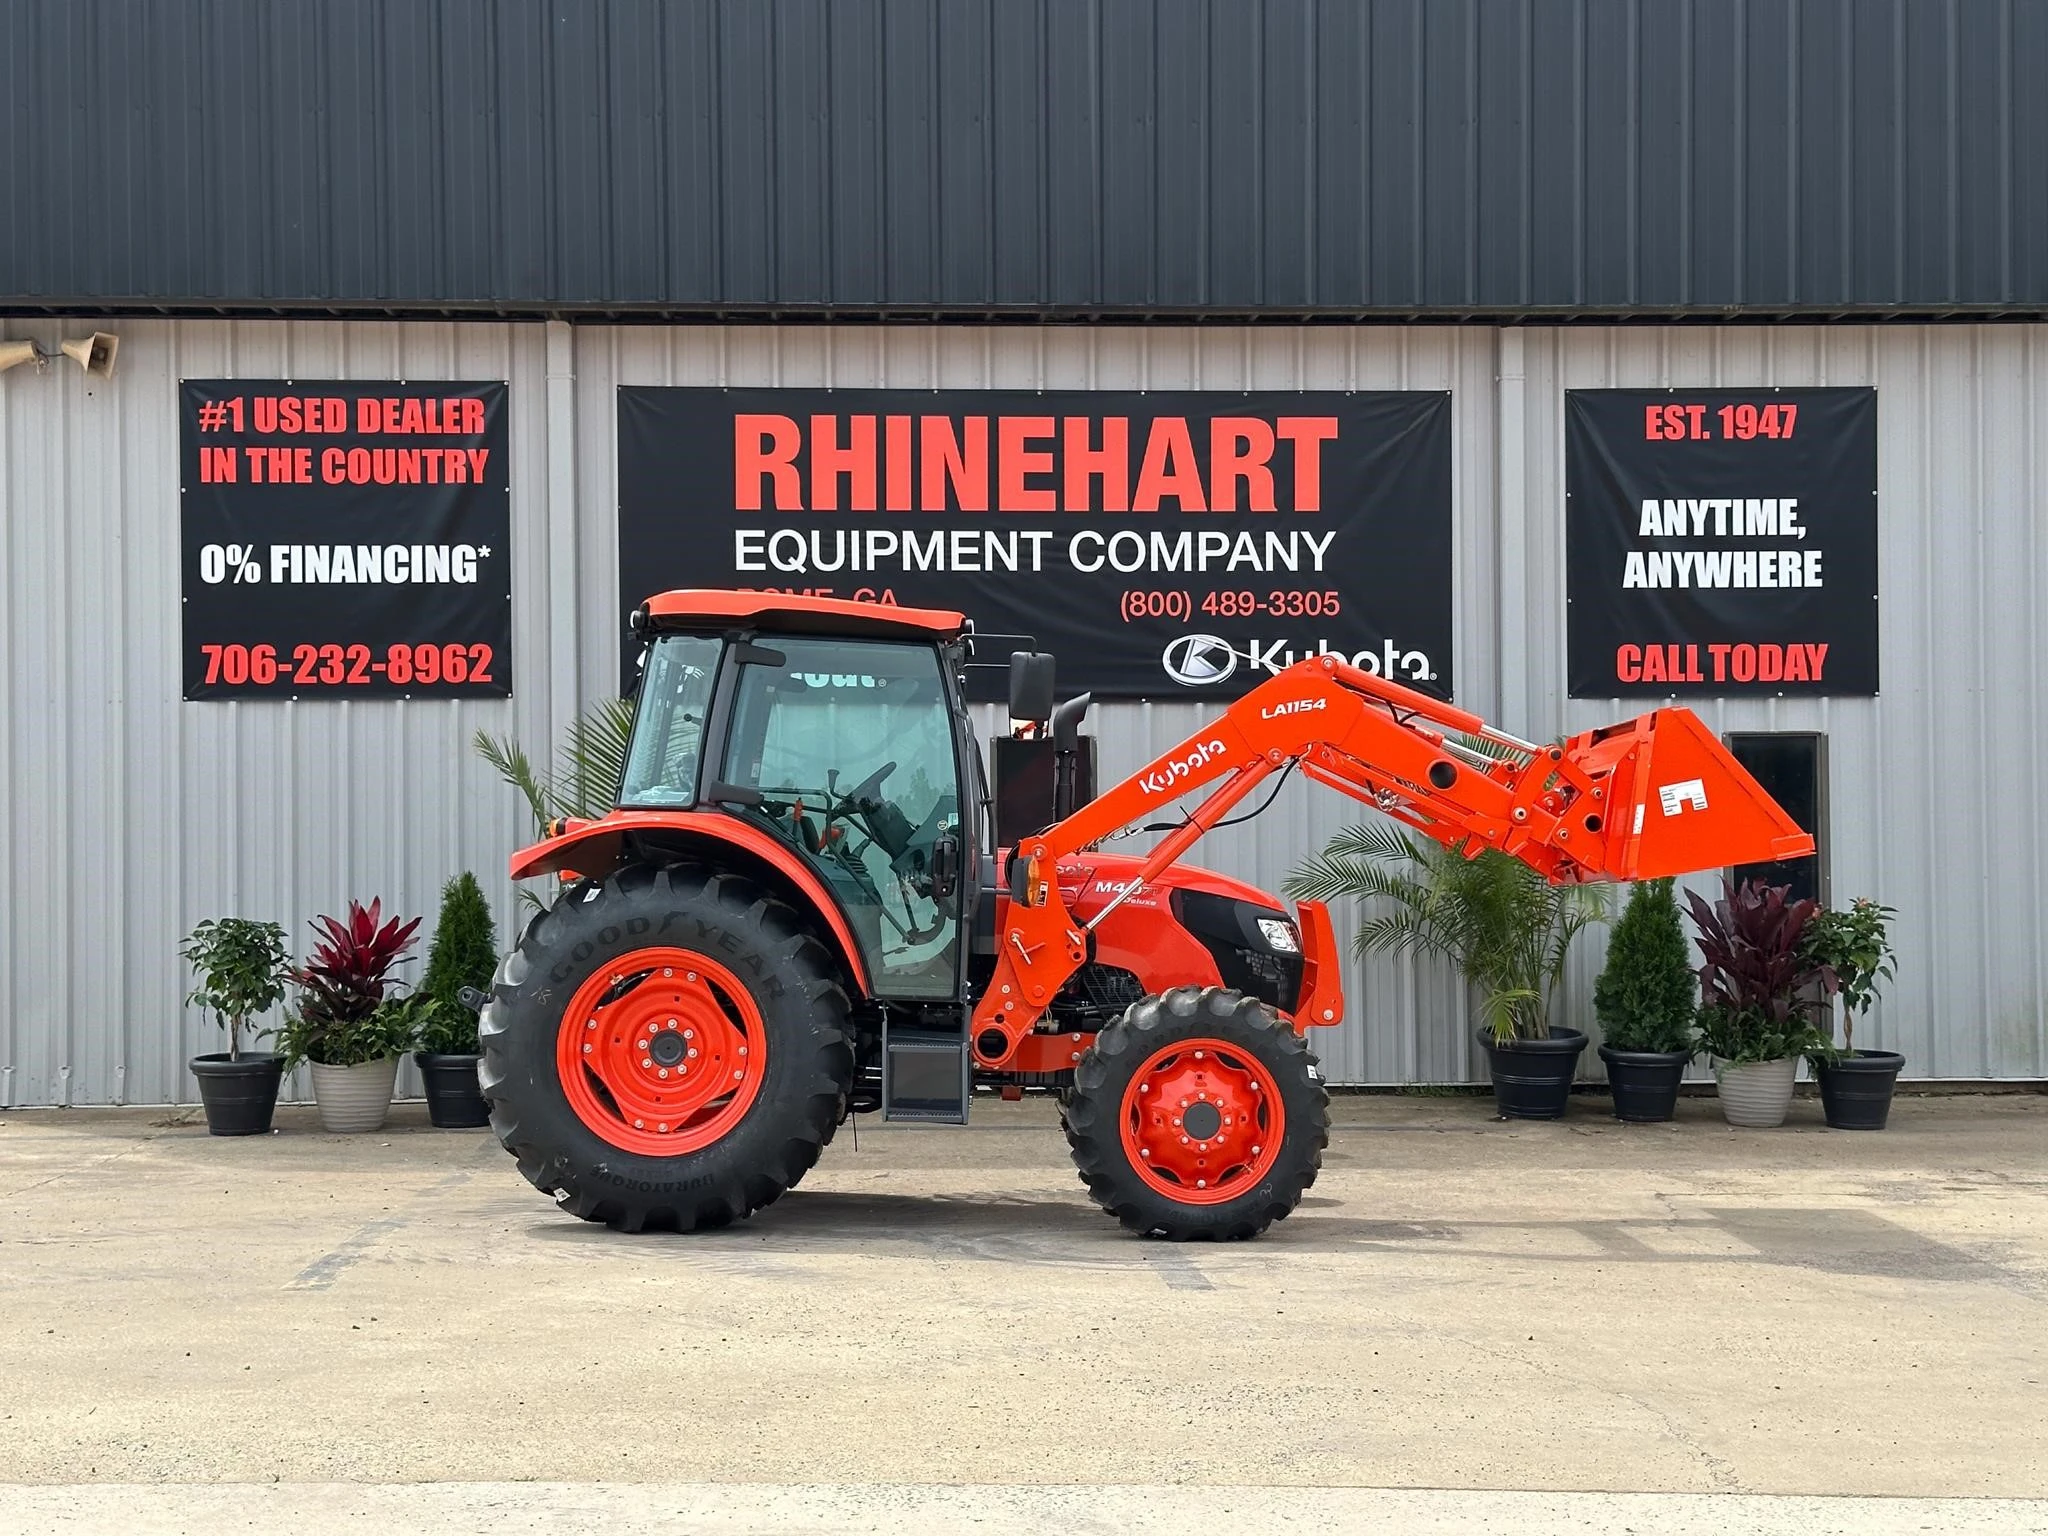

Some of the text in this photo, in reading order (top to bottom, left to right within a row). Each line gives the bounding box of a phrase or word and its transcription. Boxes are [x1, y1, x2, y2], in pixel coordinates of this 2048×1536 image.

[199, 397, 485, 434] #1 USED DEALER
[1645, 404, 1797, 440] EST. 1947
[200, 447, 490, 485] IN THE COUNTRY
[734, 414, 1338, 513] RHINEHART
[1638, 498, 1807, 540] ANYTIME,
[200, 544, 262, 584] 0%
[735, 529, 1336, 575] EQUIPMENT COMPANY
[1622, 550, 1823, 588] ANYWHERE
[1120, 590, 1340, 623] (800) 489-3305
[201, 643, 493, 685] 706-232-8962
[1616, 643, 1829, 683] CALL TODAY
[1261, 698, 1327, 720] LA1154
[1138, 739, 1227, 795] Kubota
[550, 911, 786, 1002] GOODYEAR
